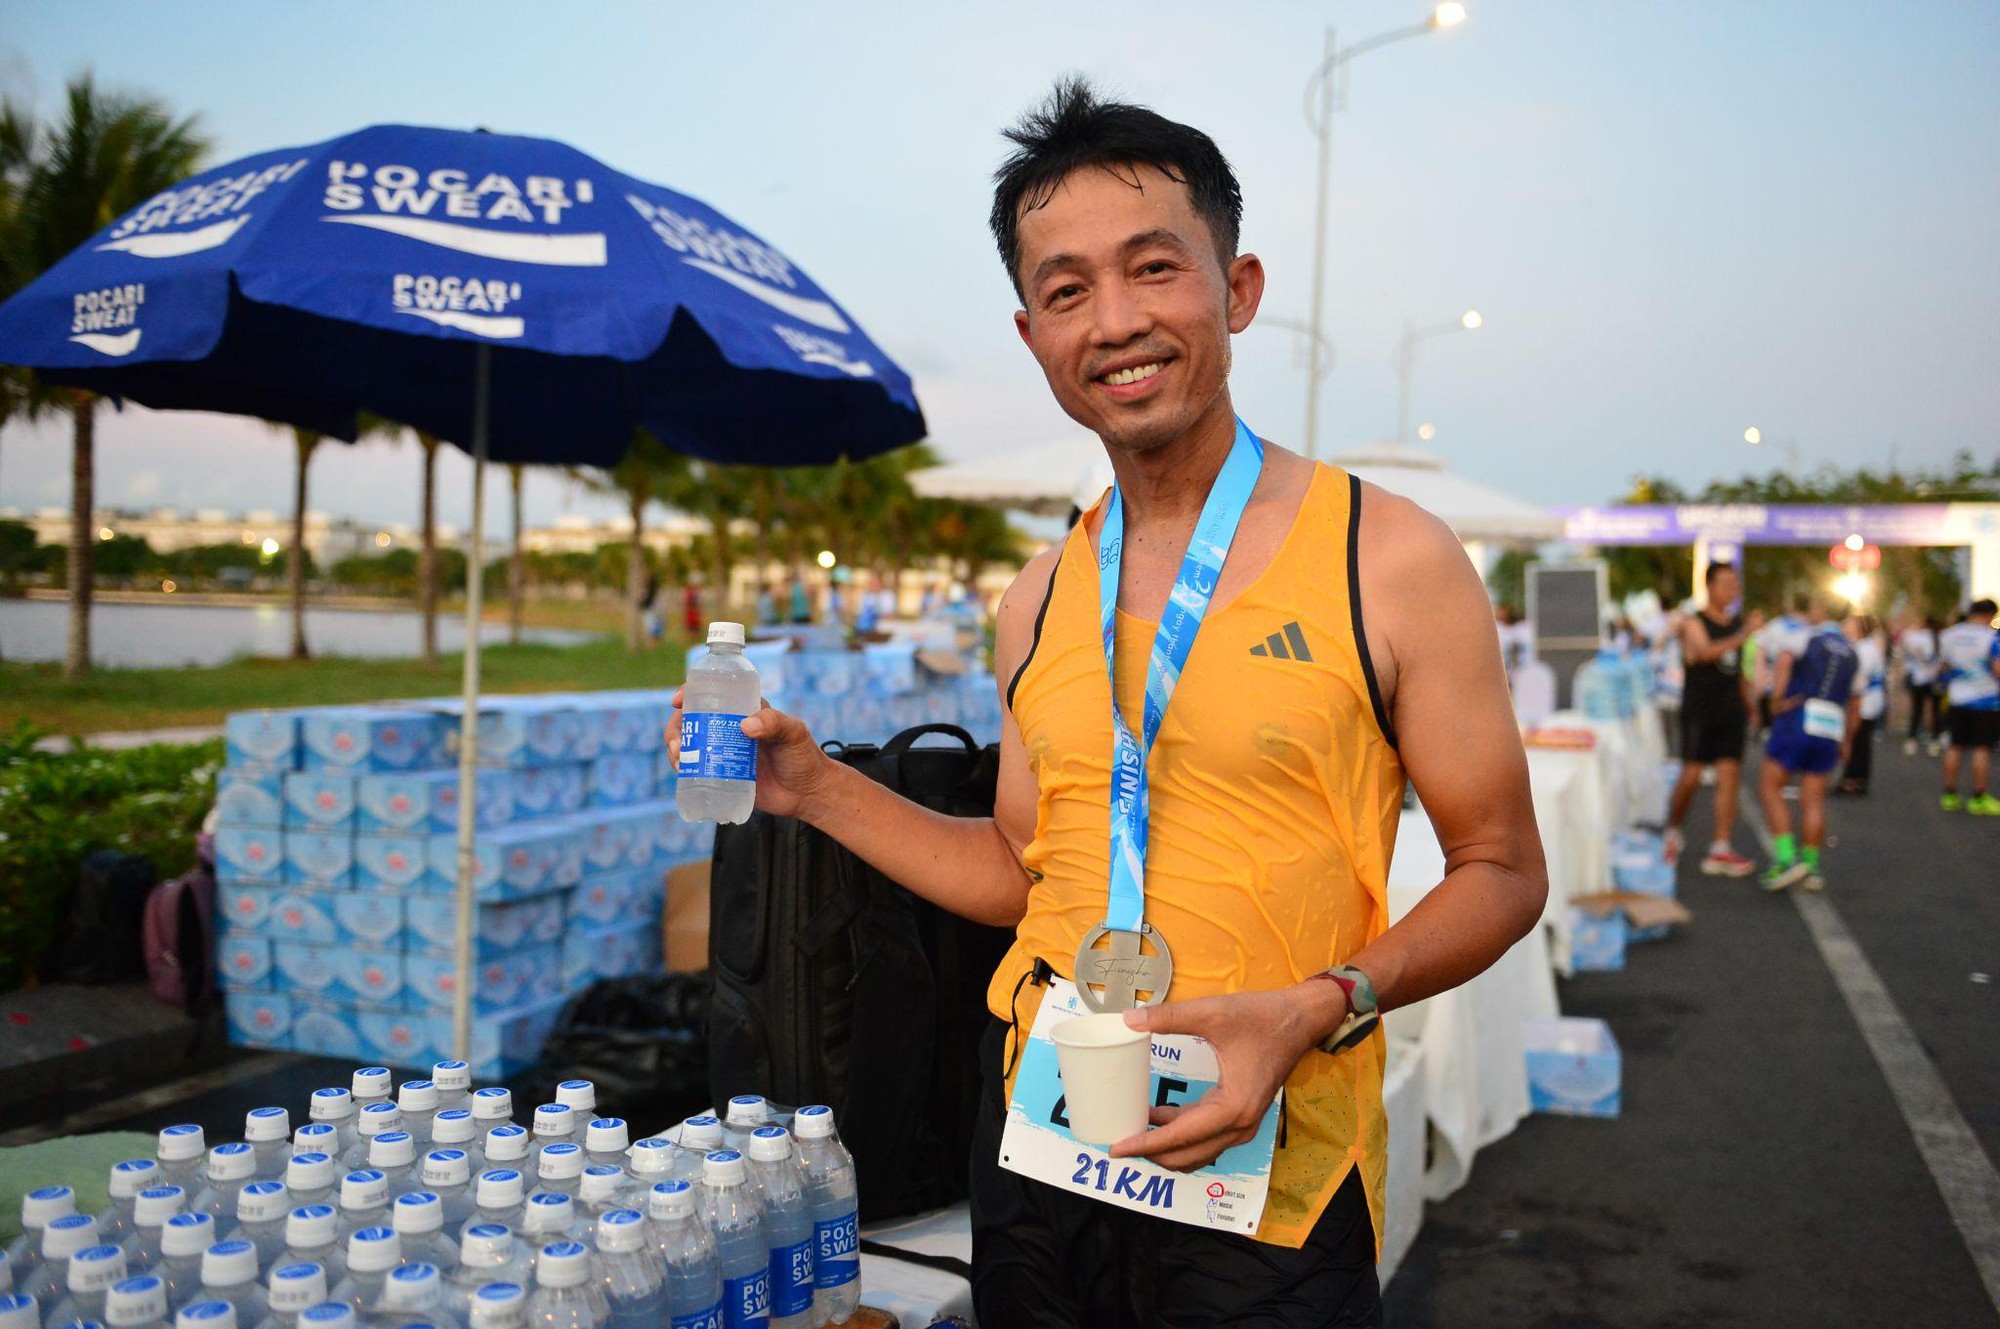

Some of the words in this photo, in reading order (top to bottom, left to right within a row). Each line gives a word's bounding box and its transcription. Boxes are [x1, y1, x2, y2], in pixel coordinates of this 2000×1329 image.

[328, 160, 594, 203] POCARI
[323, 183, 573, 224] SWEAT
[74, 283, 145, 317] POCARI
[393, 273, 522, 303] POCARI
[393, 292, 510, 312] SWEAT
[71, 304, 137, 333] SWEAT
[1150, 1043, 1181, 1062] RUN
[792, 1247, 813, 1268] PO
[743, 1274, 770, 1300] PO
